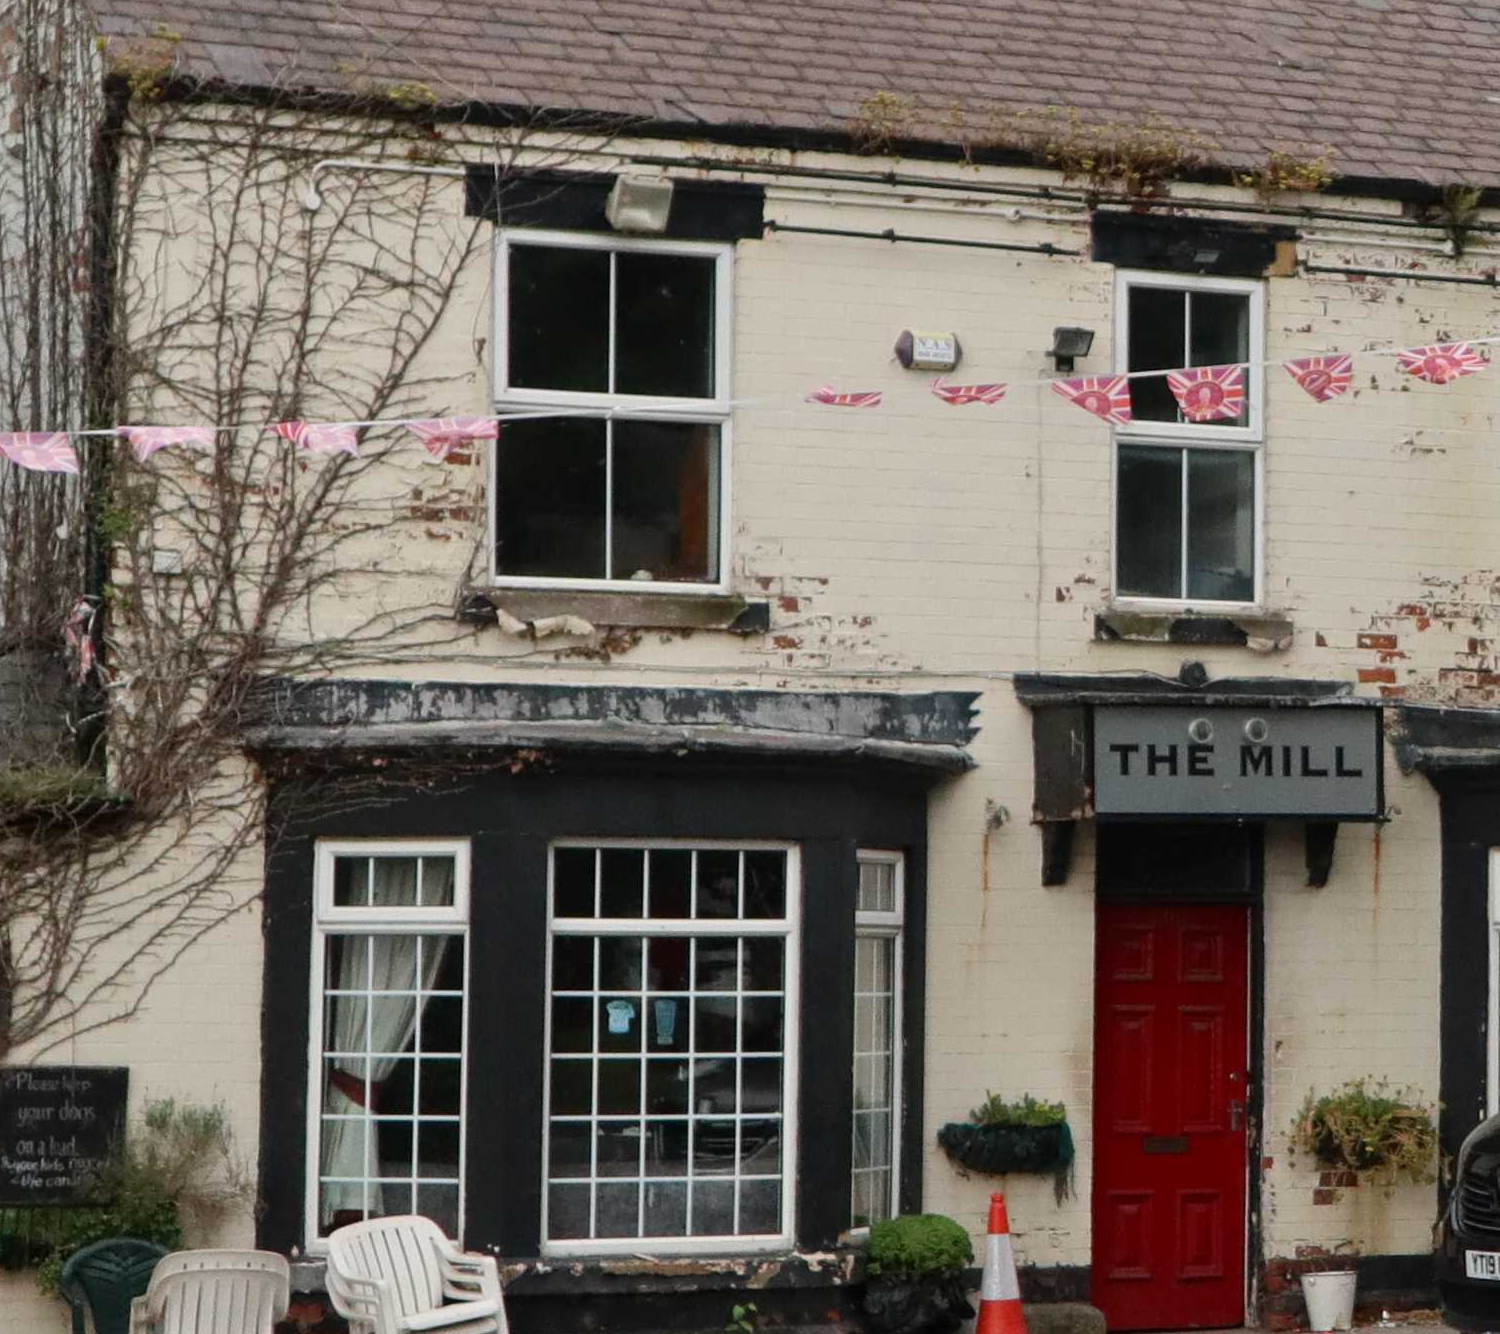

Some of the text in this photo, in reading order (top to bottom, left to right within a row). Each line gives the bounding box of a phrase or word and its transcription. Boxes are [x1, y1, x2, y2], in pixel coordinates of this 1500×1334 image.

[1109, 744, 1363, 778] THE MILL
[16, 1099, 98, 1129] your dogs
[1472, 1253, 1495, 1275] YT19
